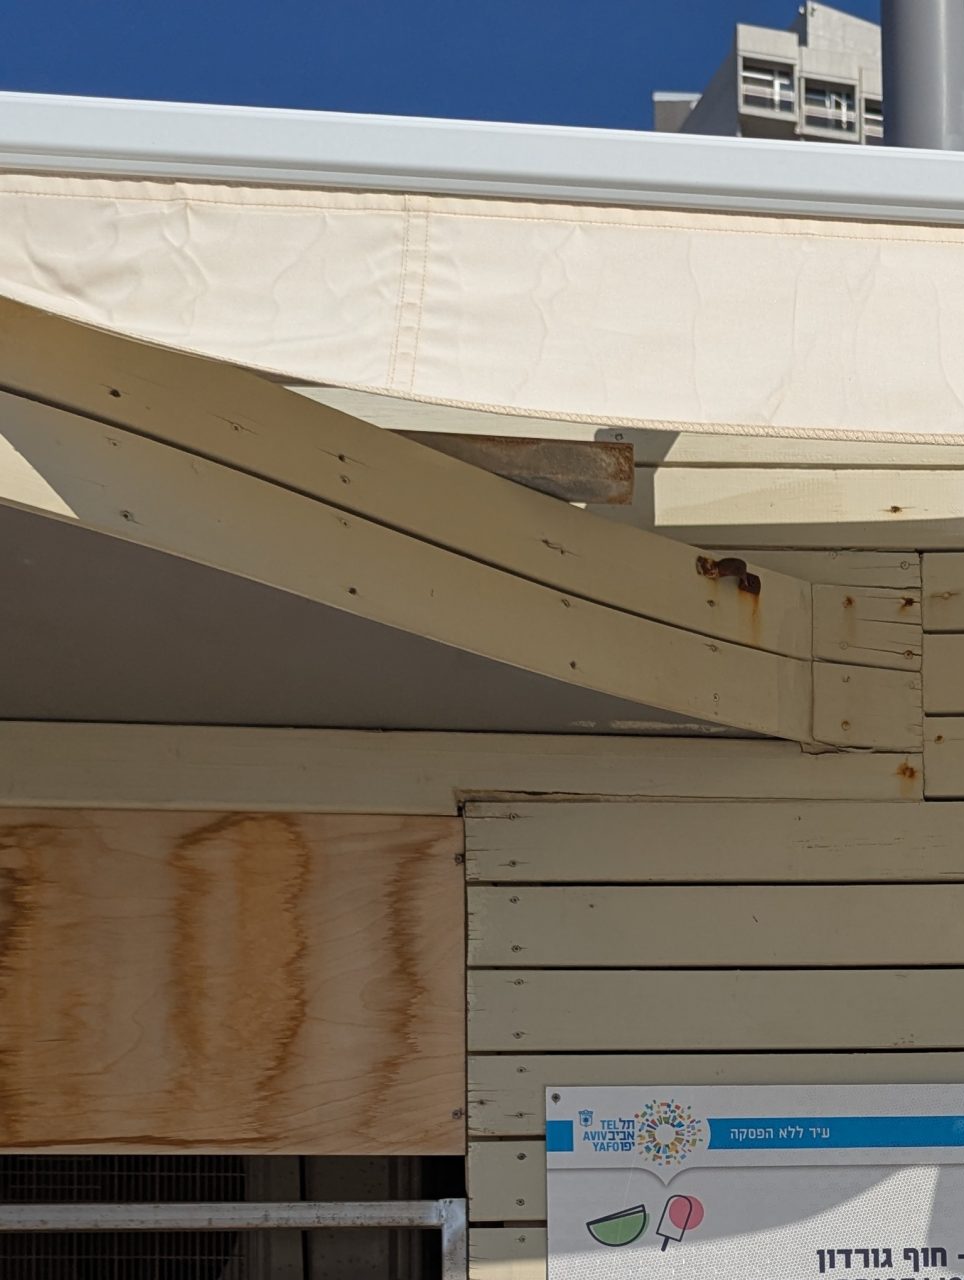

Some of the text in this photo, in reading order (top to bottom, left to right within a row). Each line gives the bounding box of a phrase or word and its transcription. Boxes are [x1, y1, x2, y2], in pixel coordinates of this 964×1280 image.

[600, 1120, 619, 1130] TEL
[619, 1117, 635, 1130] תל
[583, 1131, 607, 1141] AVIV
[608, 1131, 635, 1141] אביב
[730, 1125, 830, 1141] עיר ללא הפסקה
[592, 1141, 620, 1152] YAFO
[619, 1141, 635, 1151] יפו
[816, 1247, 893, 1275] גורדון
[903, 1246, 948, 1272] חוף
